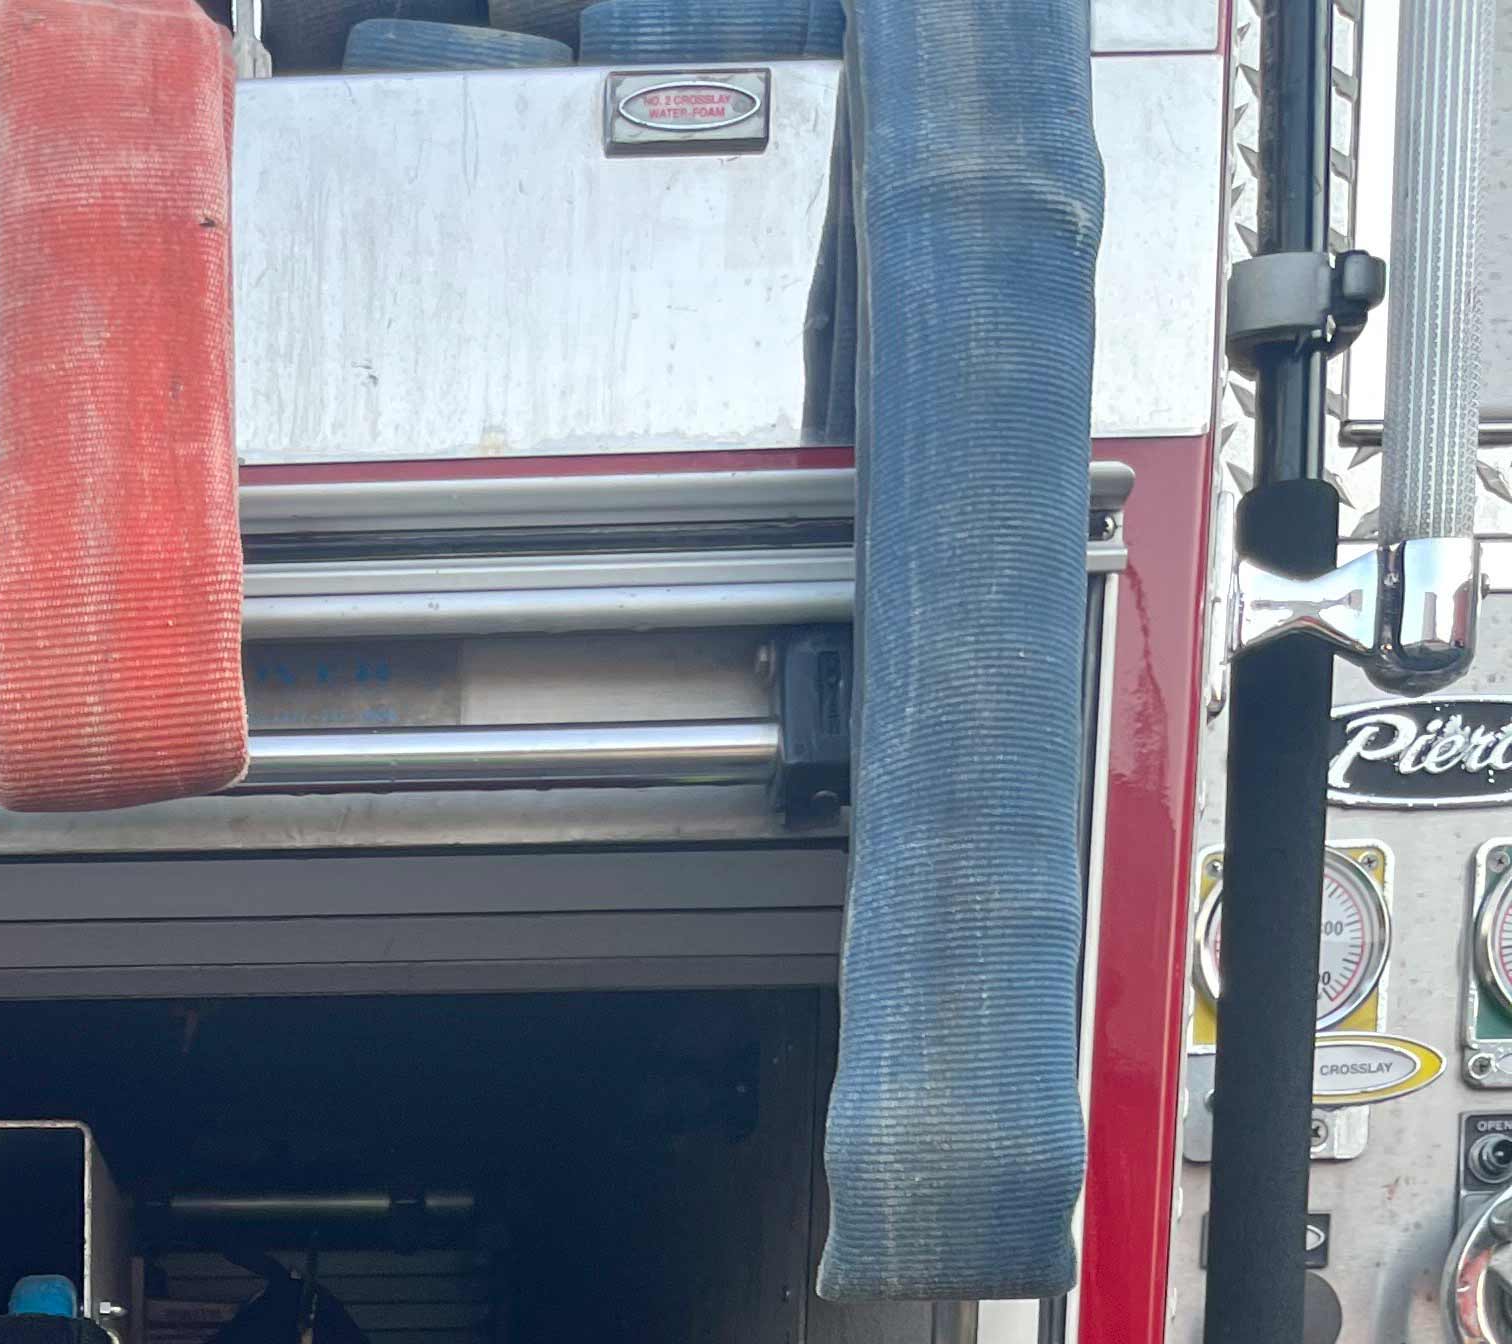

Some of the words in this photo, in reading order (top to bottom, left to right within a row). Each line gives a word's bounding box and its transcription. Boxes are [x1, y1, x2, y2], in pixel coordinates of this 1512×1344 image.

[664, 95, 671, 106] 2
[673, 94, 731, 105] CROSSLAY
[648, 107, 725, 119] WATER-FOAM
[1320, 1062, 1393, 1075] CROSSLAY
